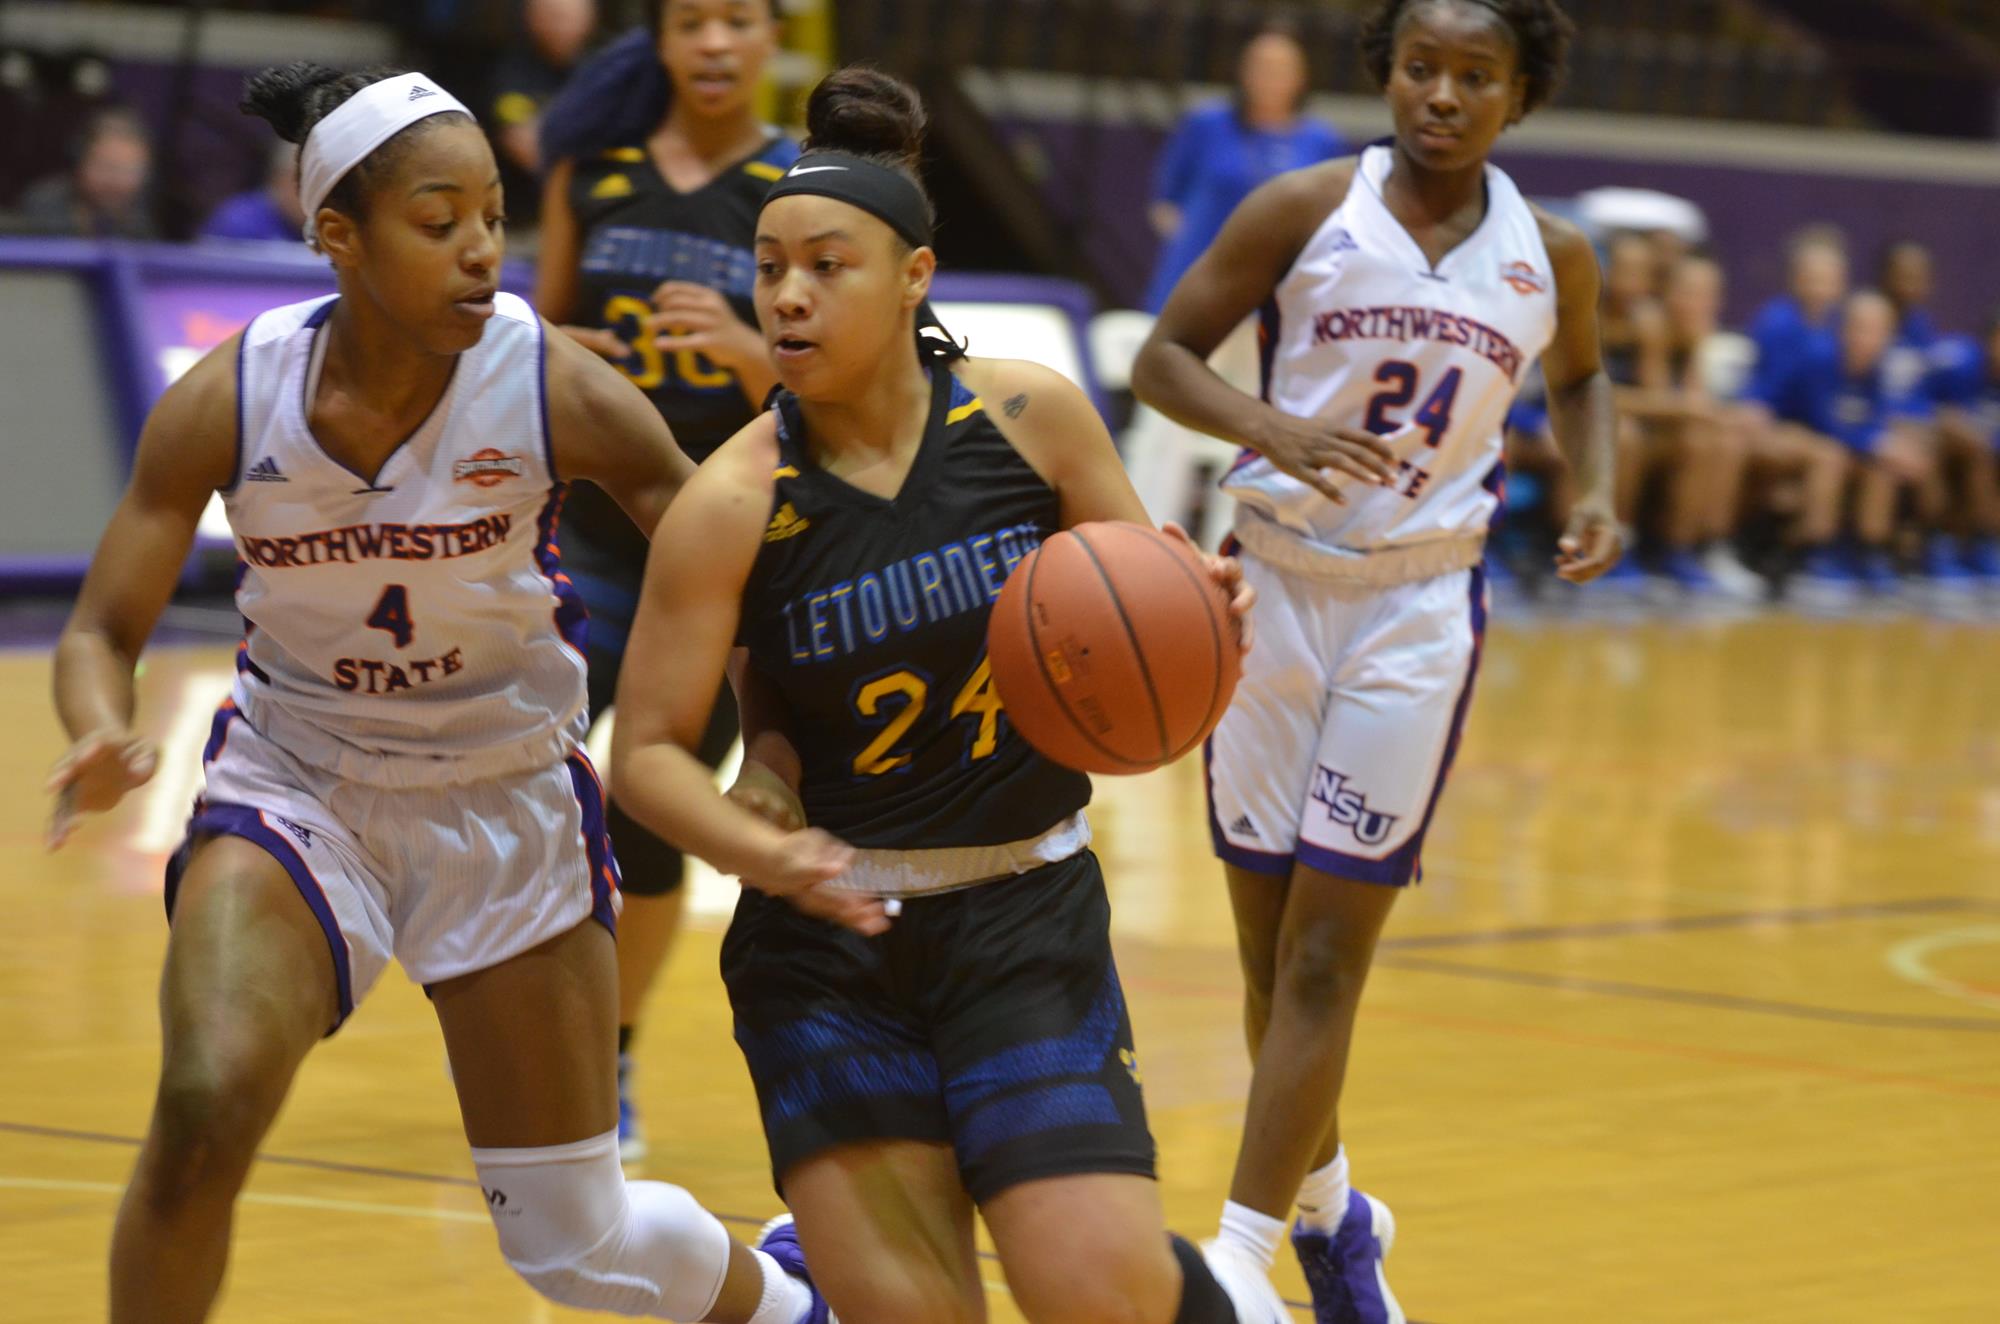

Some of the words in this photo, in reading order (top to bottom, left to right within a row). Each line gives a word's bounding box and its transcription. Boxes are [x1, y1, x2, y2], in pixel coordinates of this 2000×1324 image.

[1364, 359, 1462, 448] 24
[240, 514, 512, 568] NORTHWESTERN
[366, 583, 414, 649] 4
[334, 648, 463, 694] STATE
[852, 666, 1004, 777] 24
[1311, 762, 1401, 846] NSU
